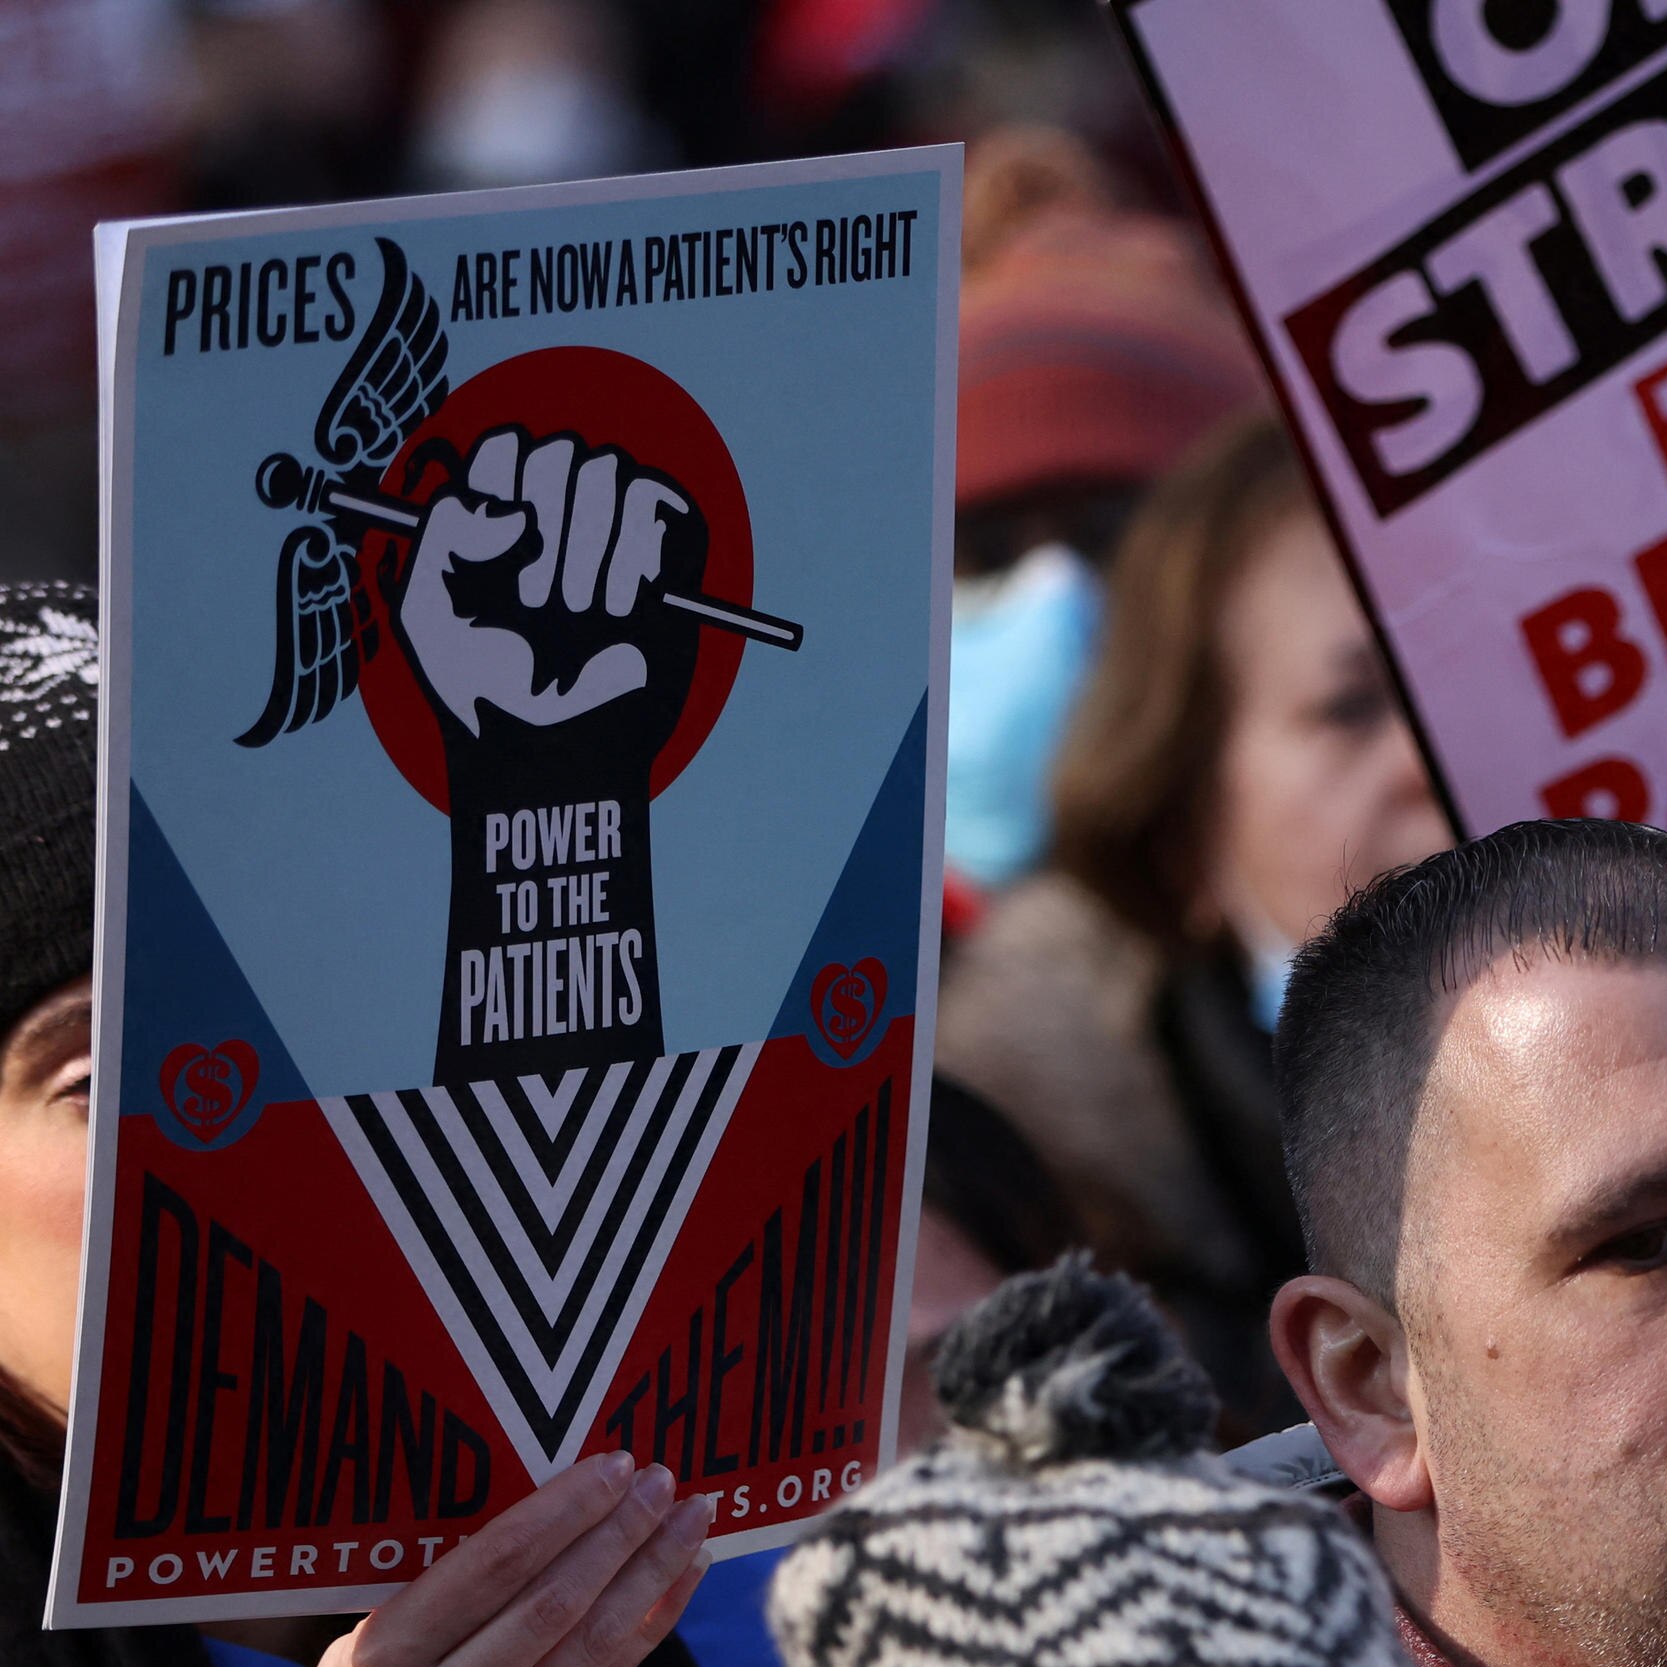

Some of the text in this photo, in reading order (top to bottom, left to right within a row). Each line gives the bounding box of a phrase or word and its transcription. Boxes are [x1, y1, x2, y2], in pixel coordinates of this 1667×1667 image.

[163, 209, 918, 356] PRICES ARE NOW A PATIENT'S RIGHT
[485, 799, 622, 874] POWER
[496, 871, 610, 934] TO THE
[460, 928, 643, 1047] PATIENTS
[114, 1169, 492, 1541] DEMAND
